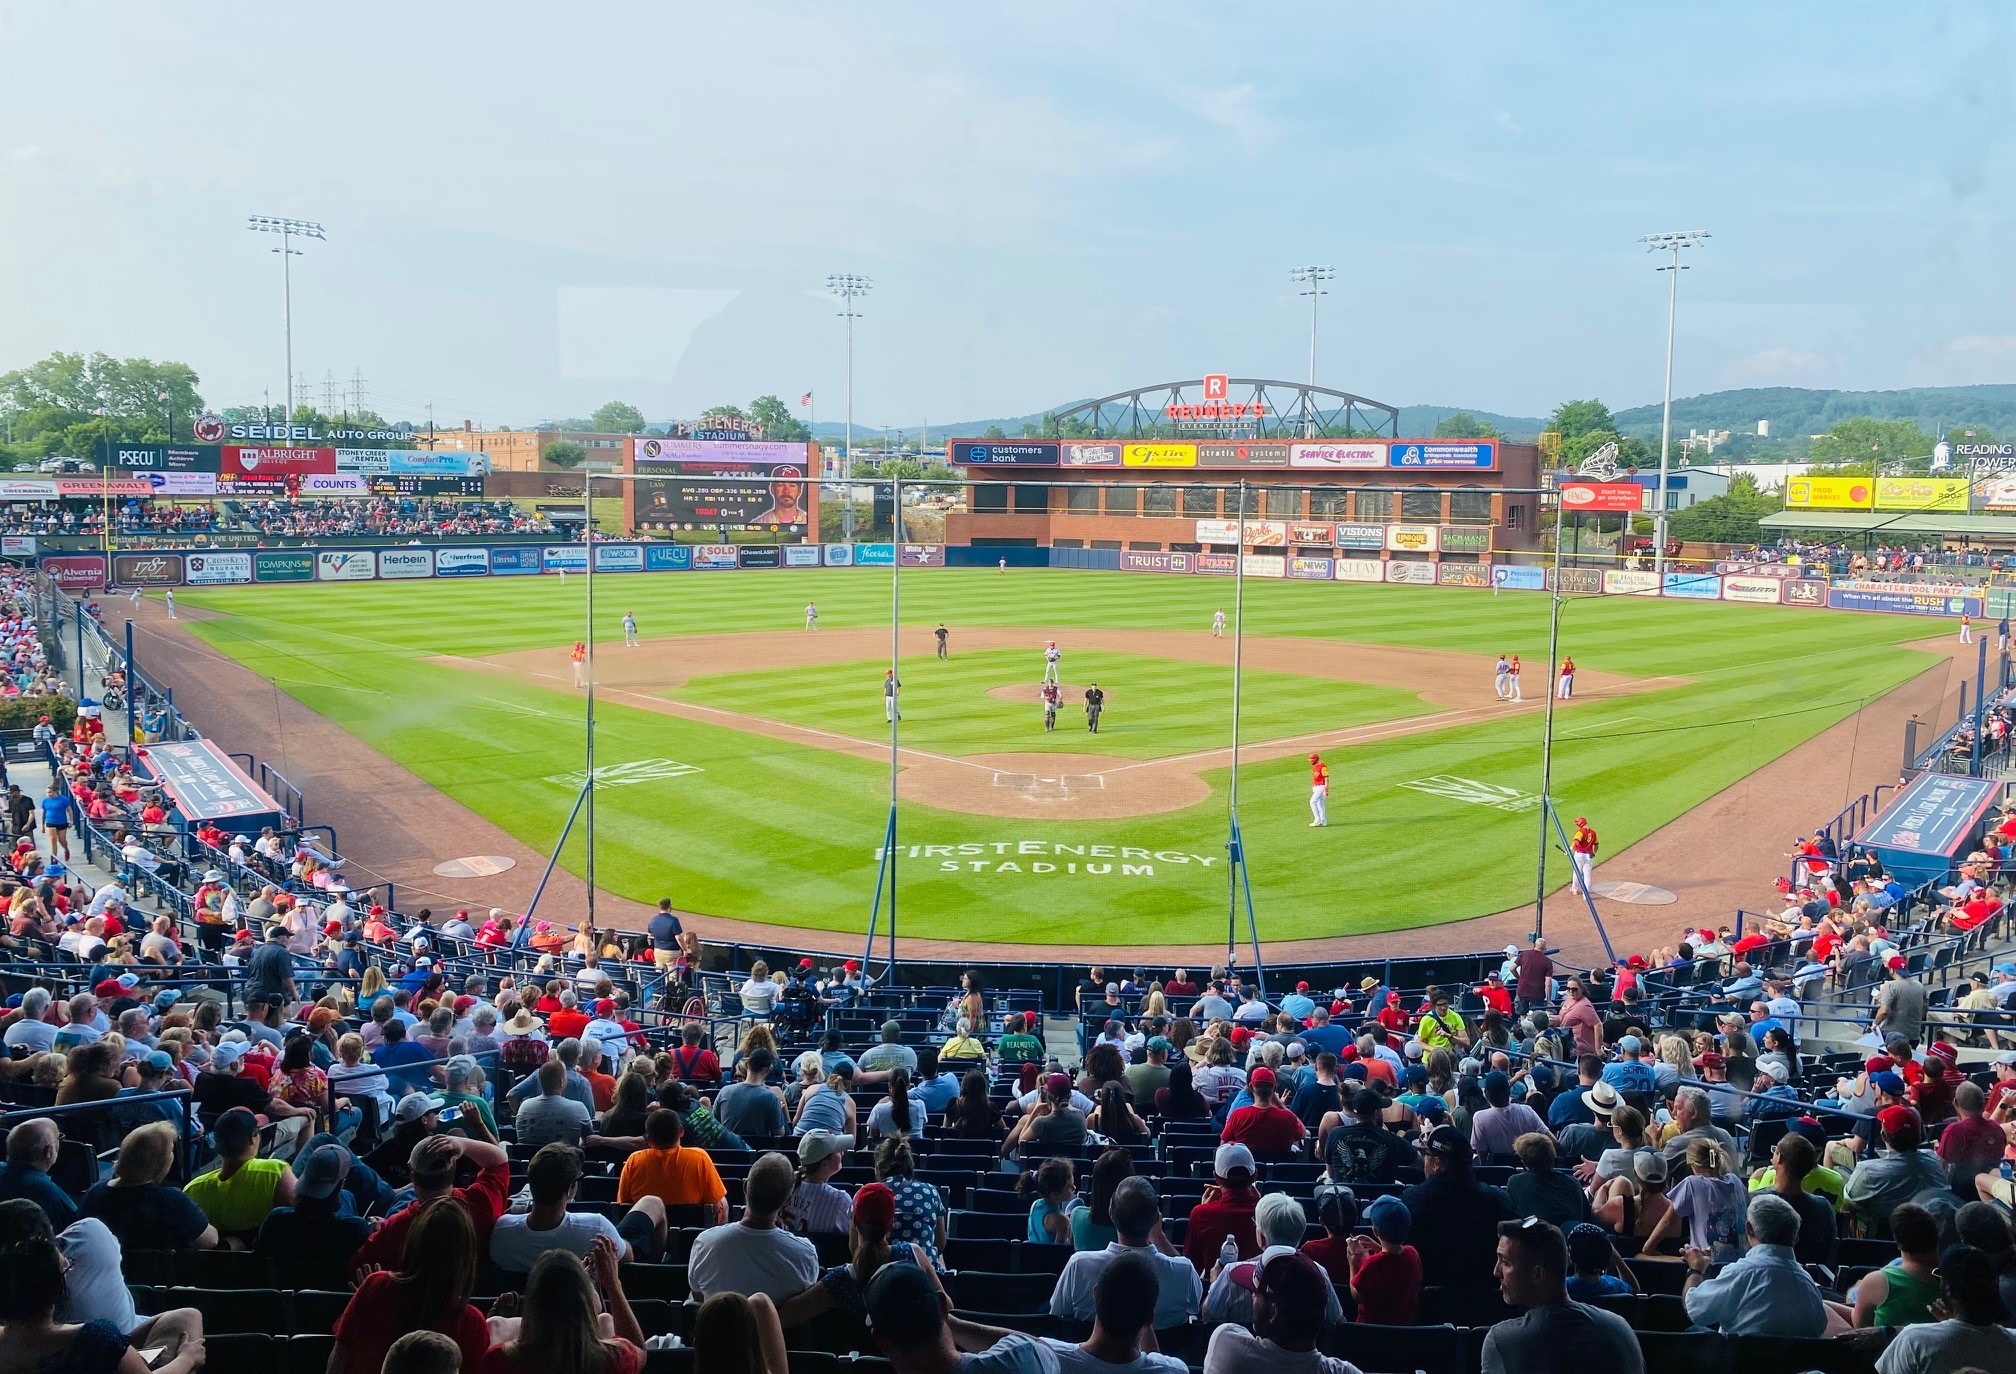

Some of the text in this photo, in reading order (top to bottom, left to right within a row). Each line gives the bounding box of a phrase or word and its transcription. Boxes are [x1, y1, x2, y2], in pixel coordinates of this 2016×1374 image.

[1209, 378, 1222, 395] R
[1168, 403, 1264, 419] REDNER'S
[231, 425, 413, 440] SEIDEL AUTO GROUP
[698, 432, 746, 440] STADIUM
[259, 449, 318, 460] ALBRIGHT
[992, 446, 1042, 454] customers
[1250, 450, 1286, 458] systems
[1299, 450, 1374, 458] SERVICE ELECTRIC
[1956, 444, 2012, 455] READING
[119, 450, 154, 466] PSECU
[992, 454, 1016, 462] bank
[314, 480, 357, 490] COUNTS
[720, 509, 727, 517] 0
[738, 509, 744, 517] 1
[1339, 528, 1382, 536] VISIONS
[1397, 533, 1427, 544] UNIQUE
[707, 547, 735, 555] SOLD
[258, 560, 301, 569] TOMPKINS
[384, 555, 426, 564] Herbein
[1128, 556, 1169, 567] TRUIST
[134, 558, 166, 575] 1787
[1303, 561, 1327, 569] NEWS
[1549, 575, 1598, 584] DSCOVERY
[1854, 583, 1905, 592] CHARACTER
[1914, 596, 1945, 606] RUSH
[874, 841, 1218, 868] FIRSTENERGY
[940, 861, 1154, 876] STADIUM
[1218, 1076, 1237, 1086] RUIZ
